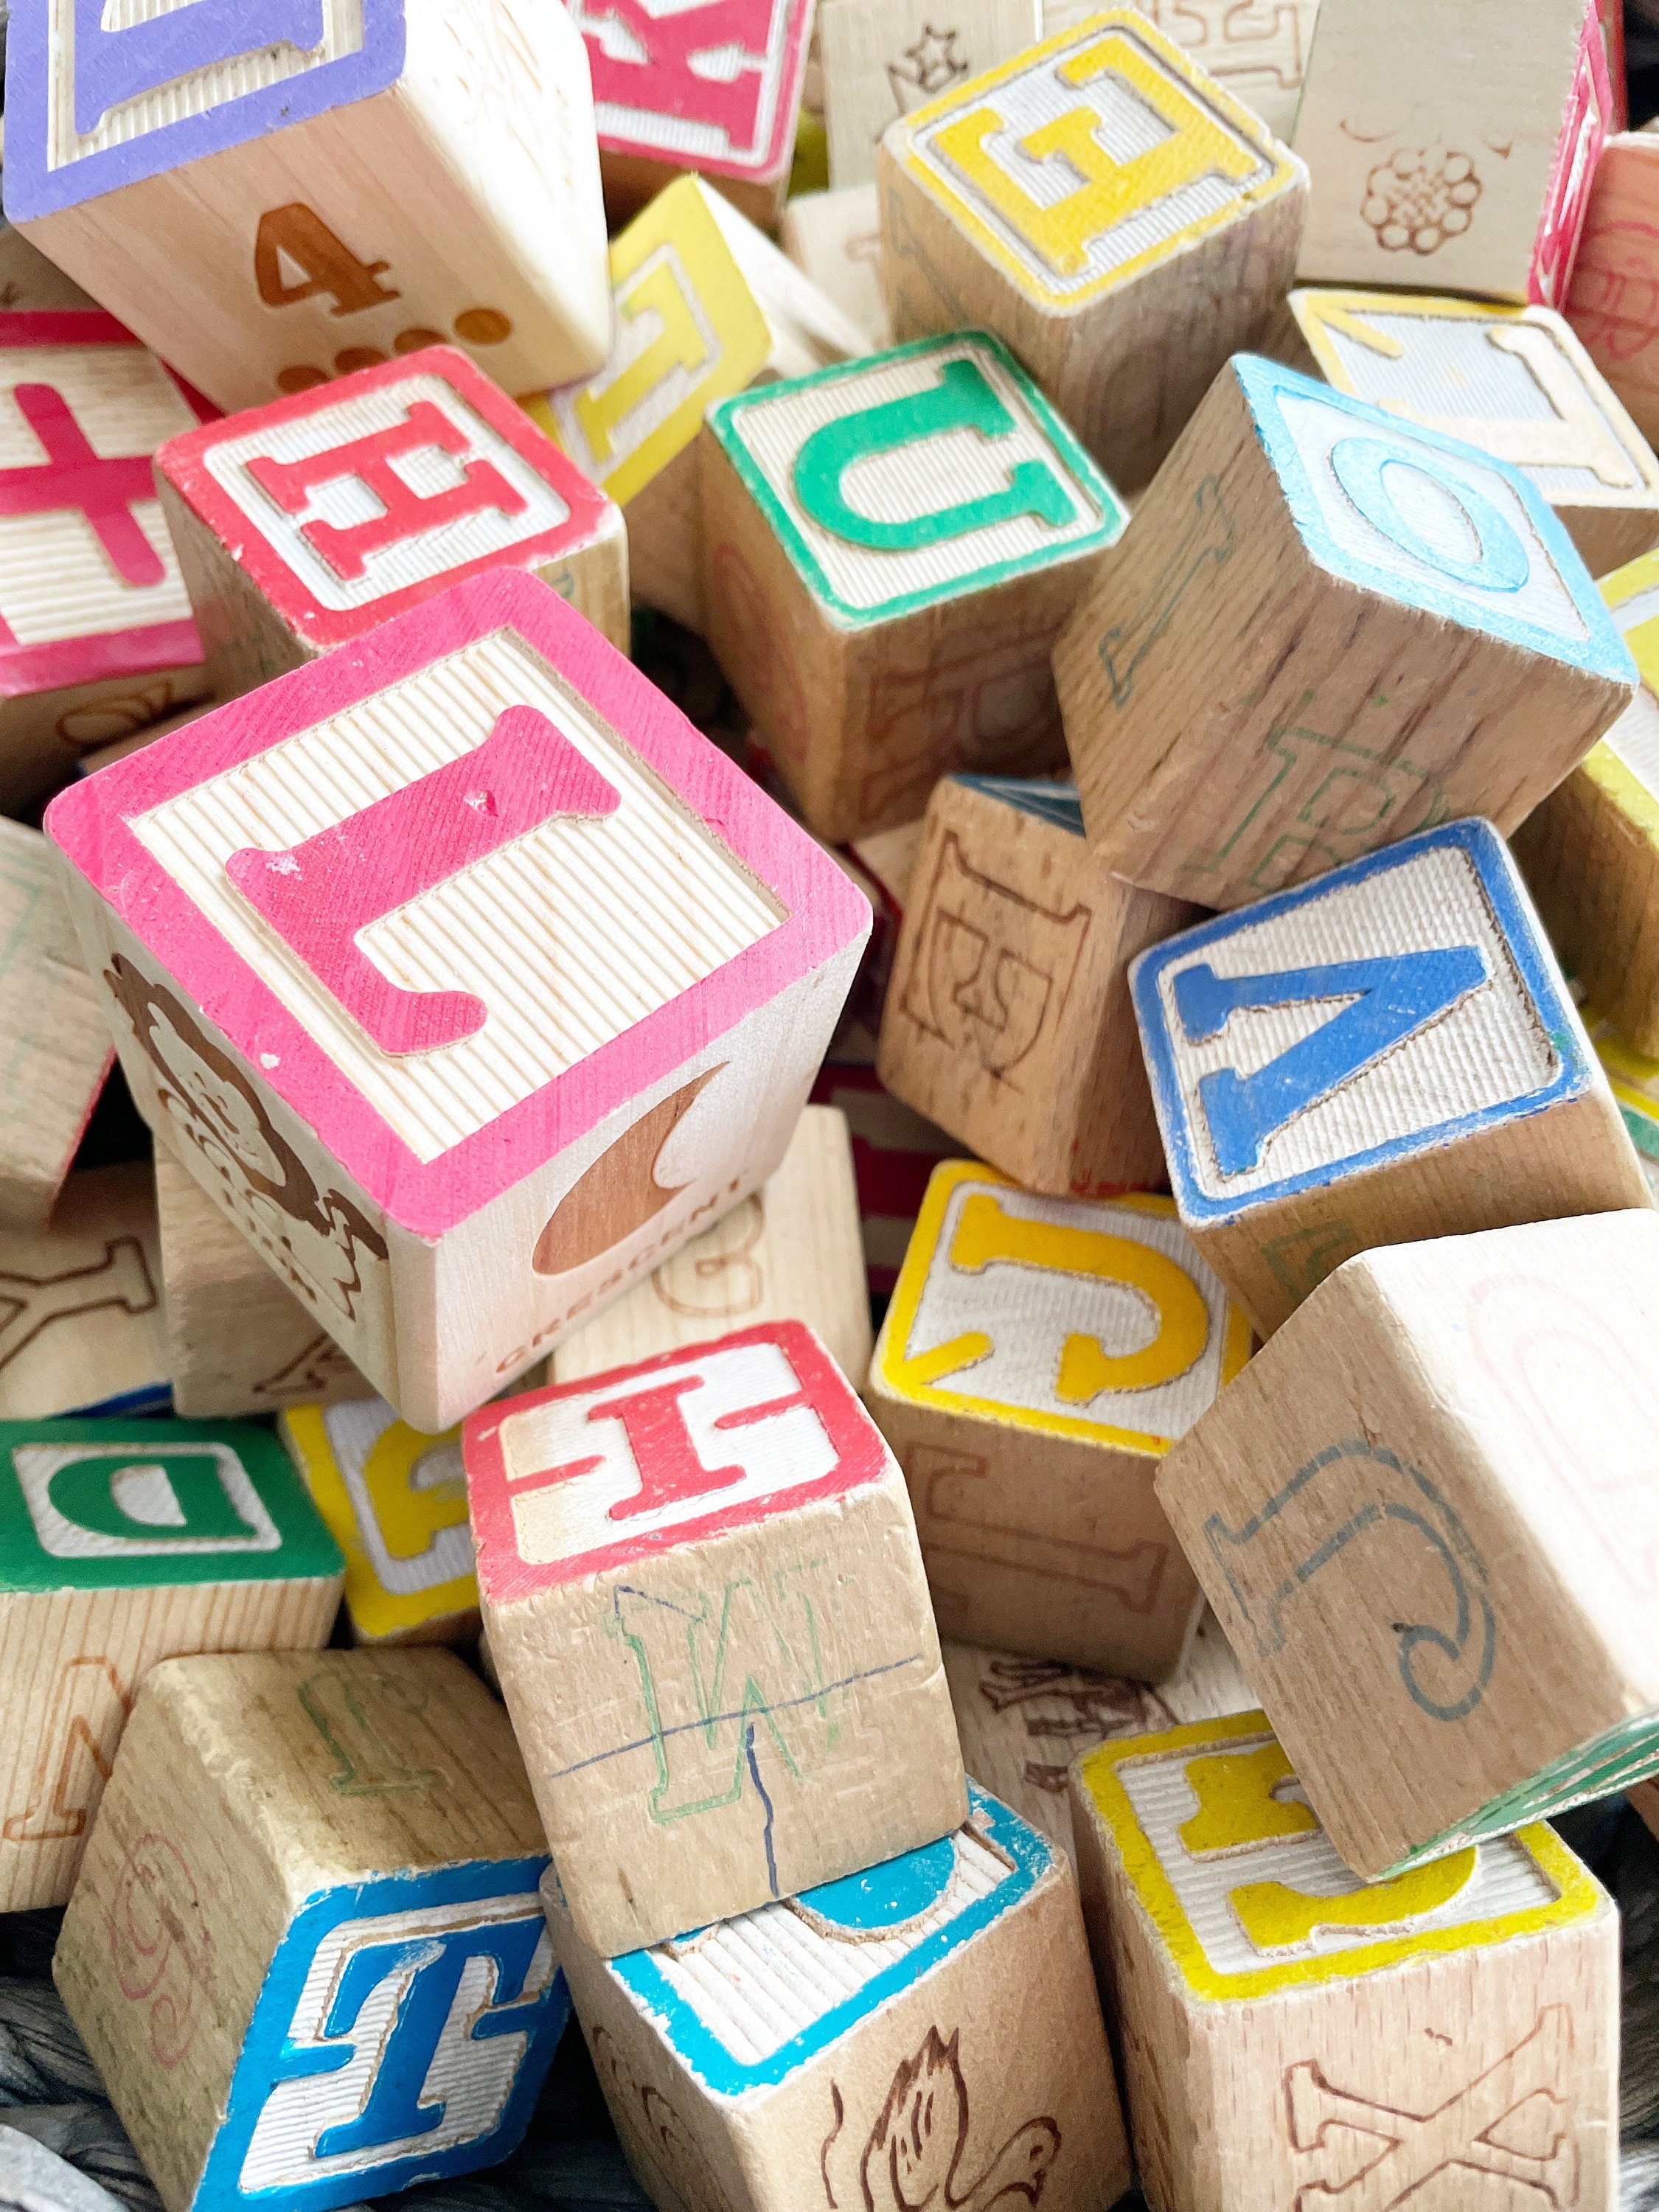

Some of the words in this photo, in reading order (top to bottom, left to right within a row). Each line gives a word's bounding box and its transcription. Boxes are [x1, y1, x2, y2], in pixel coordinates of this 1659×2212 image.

[255, 202, 403, 318] 4
[934, 36, 1258, 276] E
[246, 400, 529, 581] H
[793, 360, 1079, 549] U
[1329, 437, 1530, 593] O
[226, 704, 622, 1057] L
[1173, 945, 1489, 1175] V
[951, 1194, 1208, 1401] J
[47, 1454, 260, 1541] D
[1202, 1438, 1497, 1722] J
[315, 1917, 546, 2156] T
[1284, 2003, 1580, 2212] X
